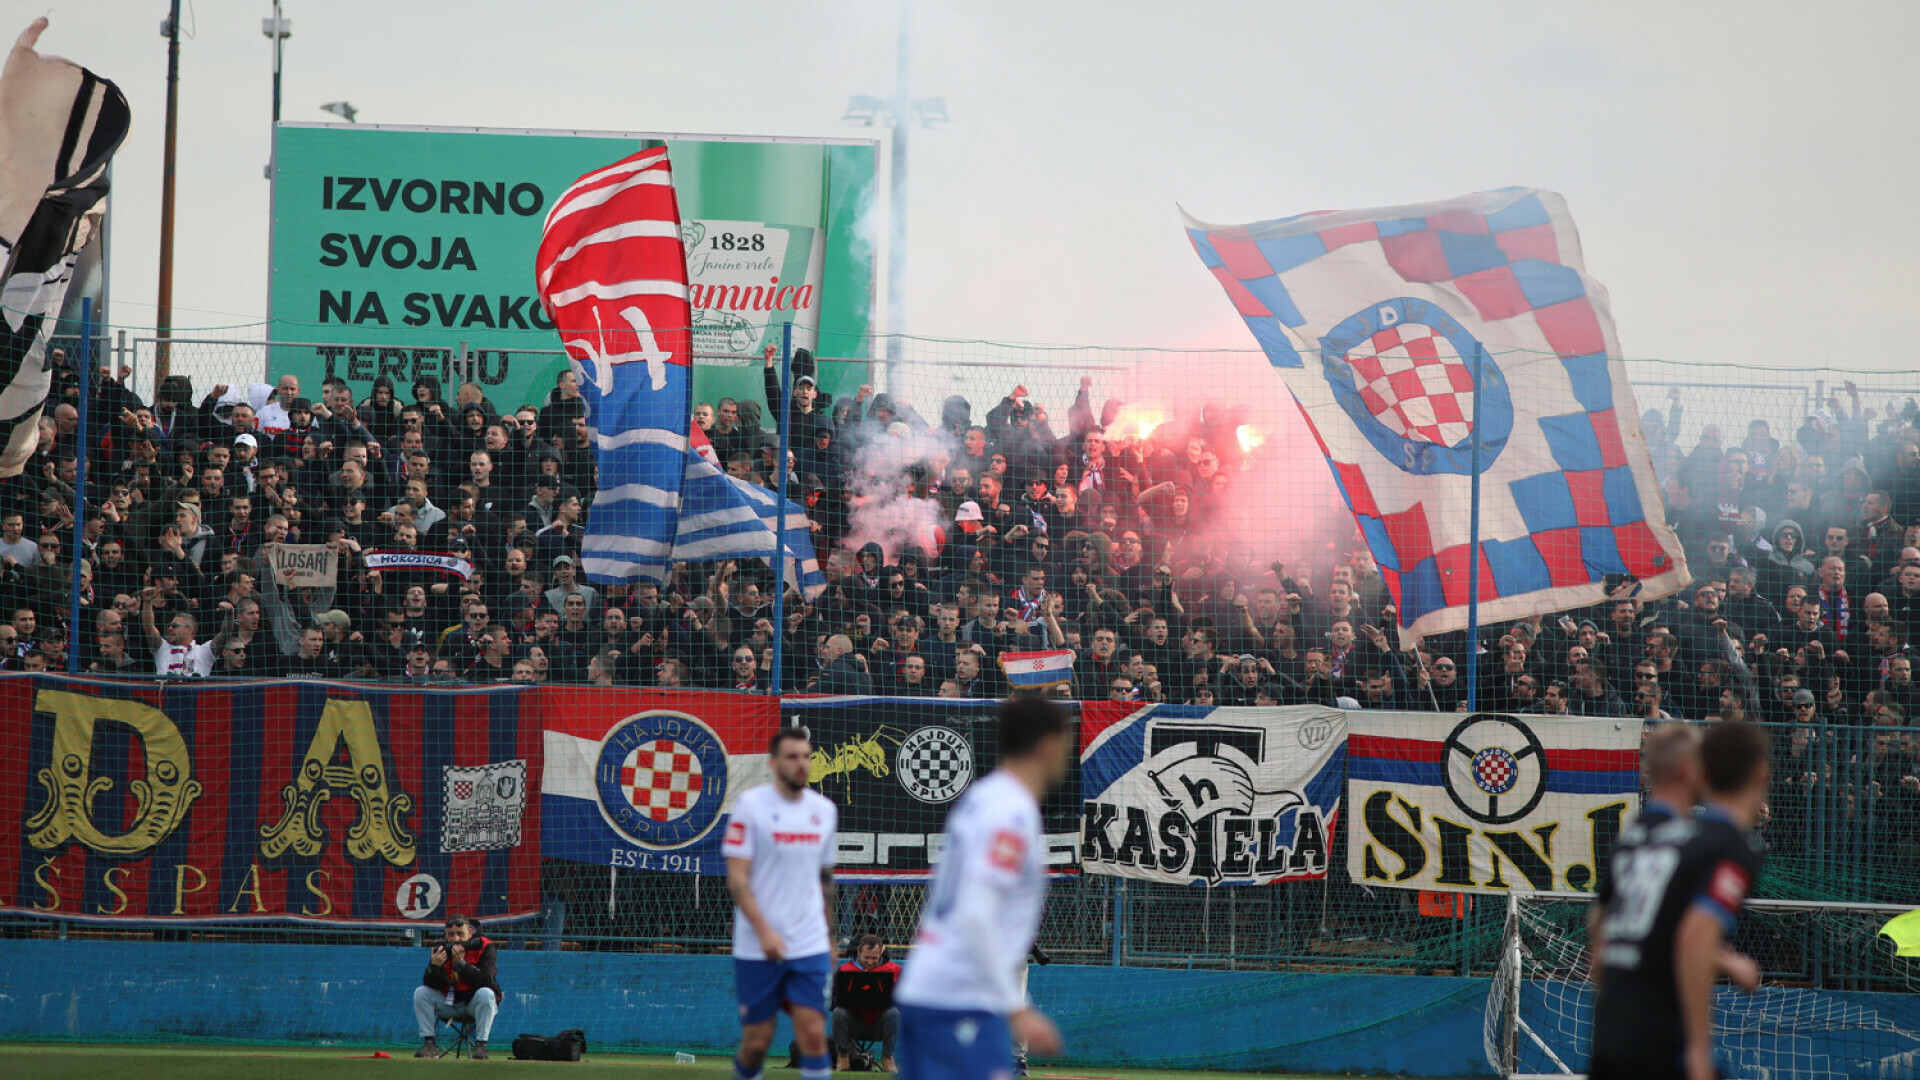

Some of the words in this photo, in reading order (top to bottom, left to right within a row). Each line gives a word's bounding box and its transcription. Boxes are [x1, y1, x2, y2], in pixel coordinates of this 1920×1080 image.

[323, 176, 544, 216] IZVORNO
[319, 233, 477, 271] SVOJA
[710, 232, 765, 251] 1828
[319, 290, 389, 325] NA
[402, 292, 558, 330] SVAKO
[689, 275, 814, 311] amnica
[316, 347, 509, 385] TERENU
[615, 719, 716, 759] HAJDUK
[905, 730, 965, 755] HAJDUK
[910, 782, 956, 800] SPLIT
[1479, 780, 1508, 793] SPLIT
[615, 807, 697, 842] SPLIT
[610, 848, 656, 870] EST.
[660, 854, 702, 873] 1911
[404, 881, 431, 911] R
